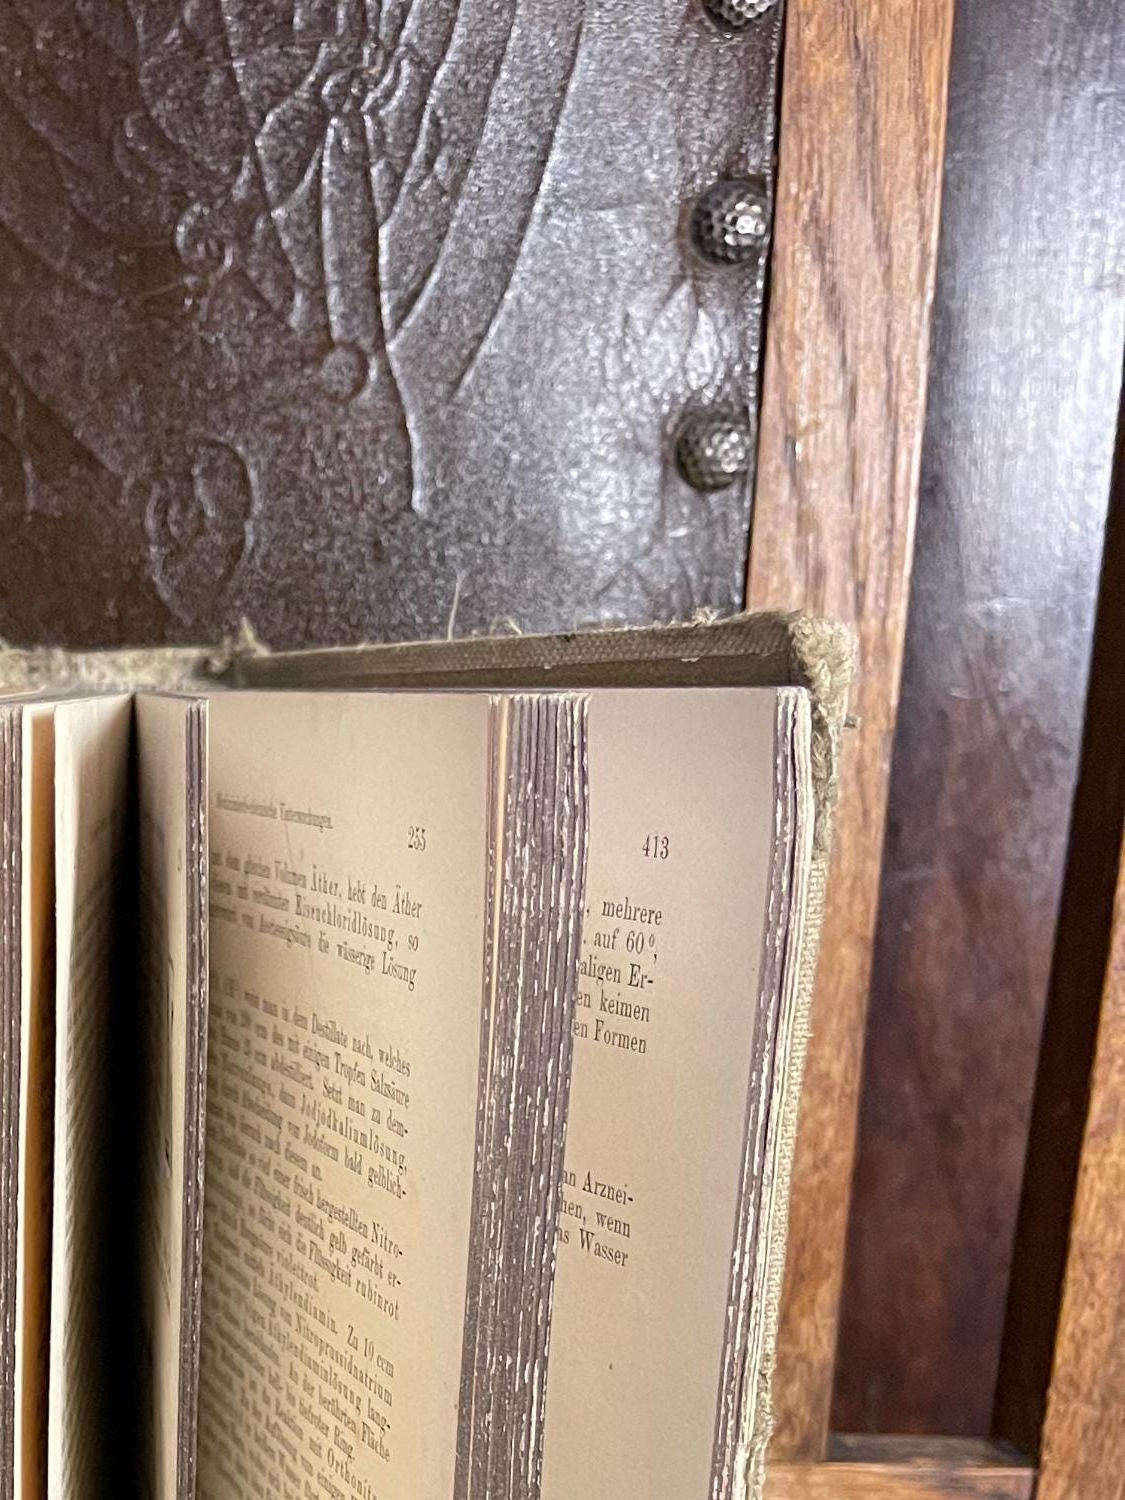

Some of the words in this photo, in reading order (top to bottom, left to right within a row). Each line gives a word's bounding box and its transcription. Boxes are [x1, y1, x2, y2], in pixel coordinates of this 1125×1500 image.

[408, 825, 426, 851] 255
[641, 835, 669, 860] 413
[295, 894, 398, 951] Eisenchloridlösung,
[408, 934, 419, 951] so
[371, 884, 387, 910] den
[393, 885, 422, 918] Äther
[602, 897, 662, 926] mehrere
[594, 928, 619, 950] auf
[337, 941, 375, 975] wässerige
[382, 951, 416, 991] Lösung
[628, 963, 654, 989] Er-
[599, 989, 650, 1023] keimen
[311, 1013, 347, 1048] Destillate
[352, 1033, 373, 1060] nach,
[378, 1044, 410, 1077] welches
[593, 1018, 647, 1054] Formen
[303, 1041, 330, 1071] einigen
[335, 1052, 365, 1087] Tropfen
[370, 1069, 409, 1109] Salzsäure
[301, 1094, 407, 1176] Jodjodkaliumlösung,
[348, 1096, 365, 1117] man
[371, 1107, 381, 1124] zu
[387, 1109, 408, 1137] dem-
[345, 1146, 362, 1175] bald
[368, 1164, 406, 1199] gelblich-
[582, 1171, 633, 1205] Arznei-
[317, 1189, 368, 1238] hergestellten
[371, 1221, 403, 1258] Nitro-
[596, 1211, 630, 1238] wenn
[329, 1231, 347, 1258] gelb
[351, 1245, 383, 1279] gefärbt
[387, 1270, 401, 1288] er-
[579, 1228, 628, 1266] Wasser
[309, 1239, 351, 1287] Flüssigkeit
[355, 1279, 399, 1320] rubinrot
[295, 1311, 393, 1406] Nitroprussidnatrium
[347, 1324, 358, 1351] Zu
[377, 1354, 394, 1378] ccm
[318, 1385, 357, 1435] berührten
[362, 1421, 390, 1461] Fläche
[368, 1397, 391, 1440] lang-
